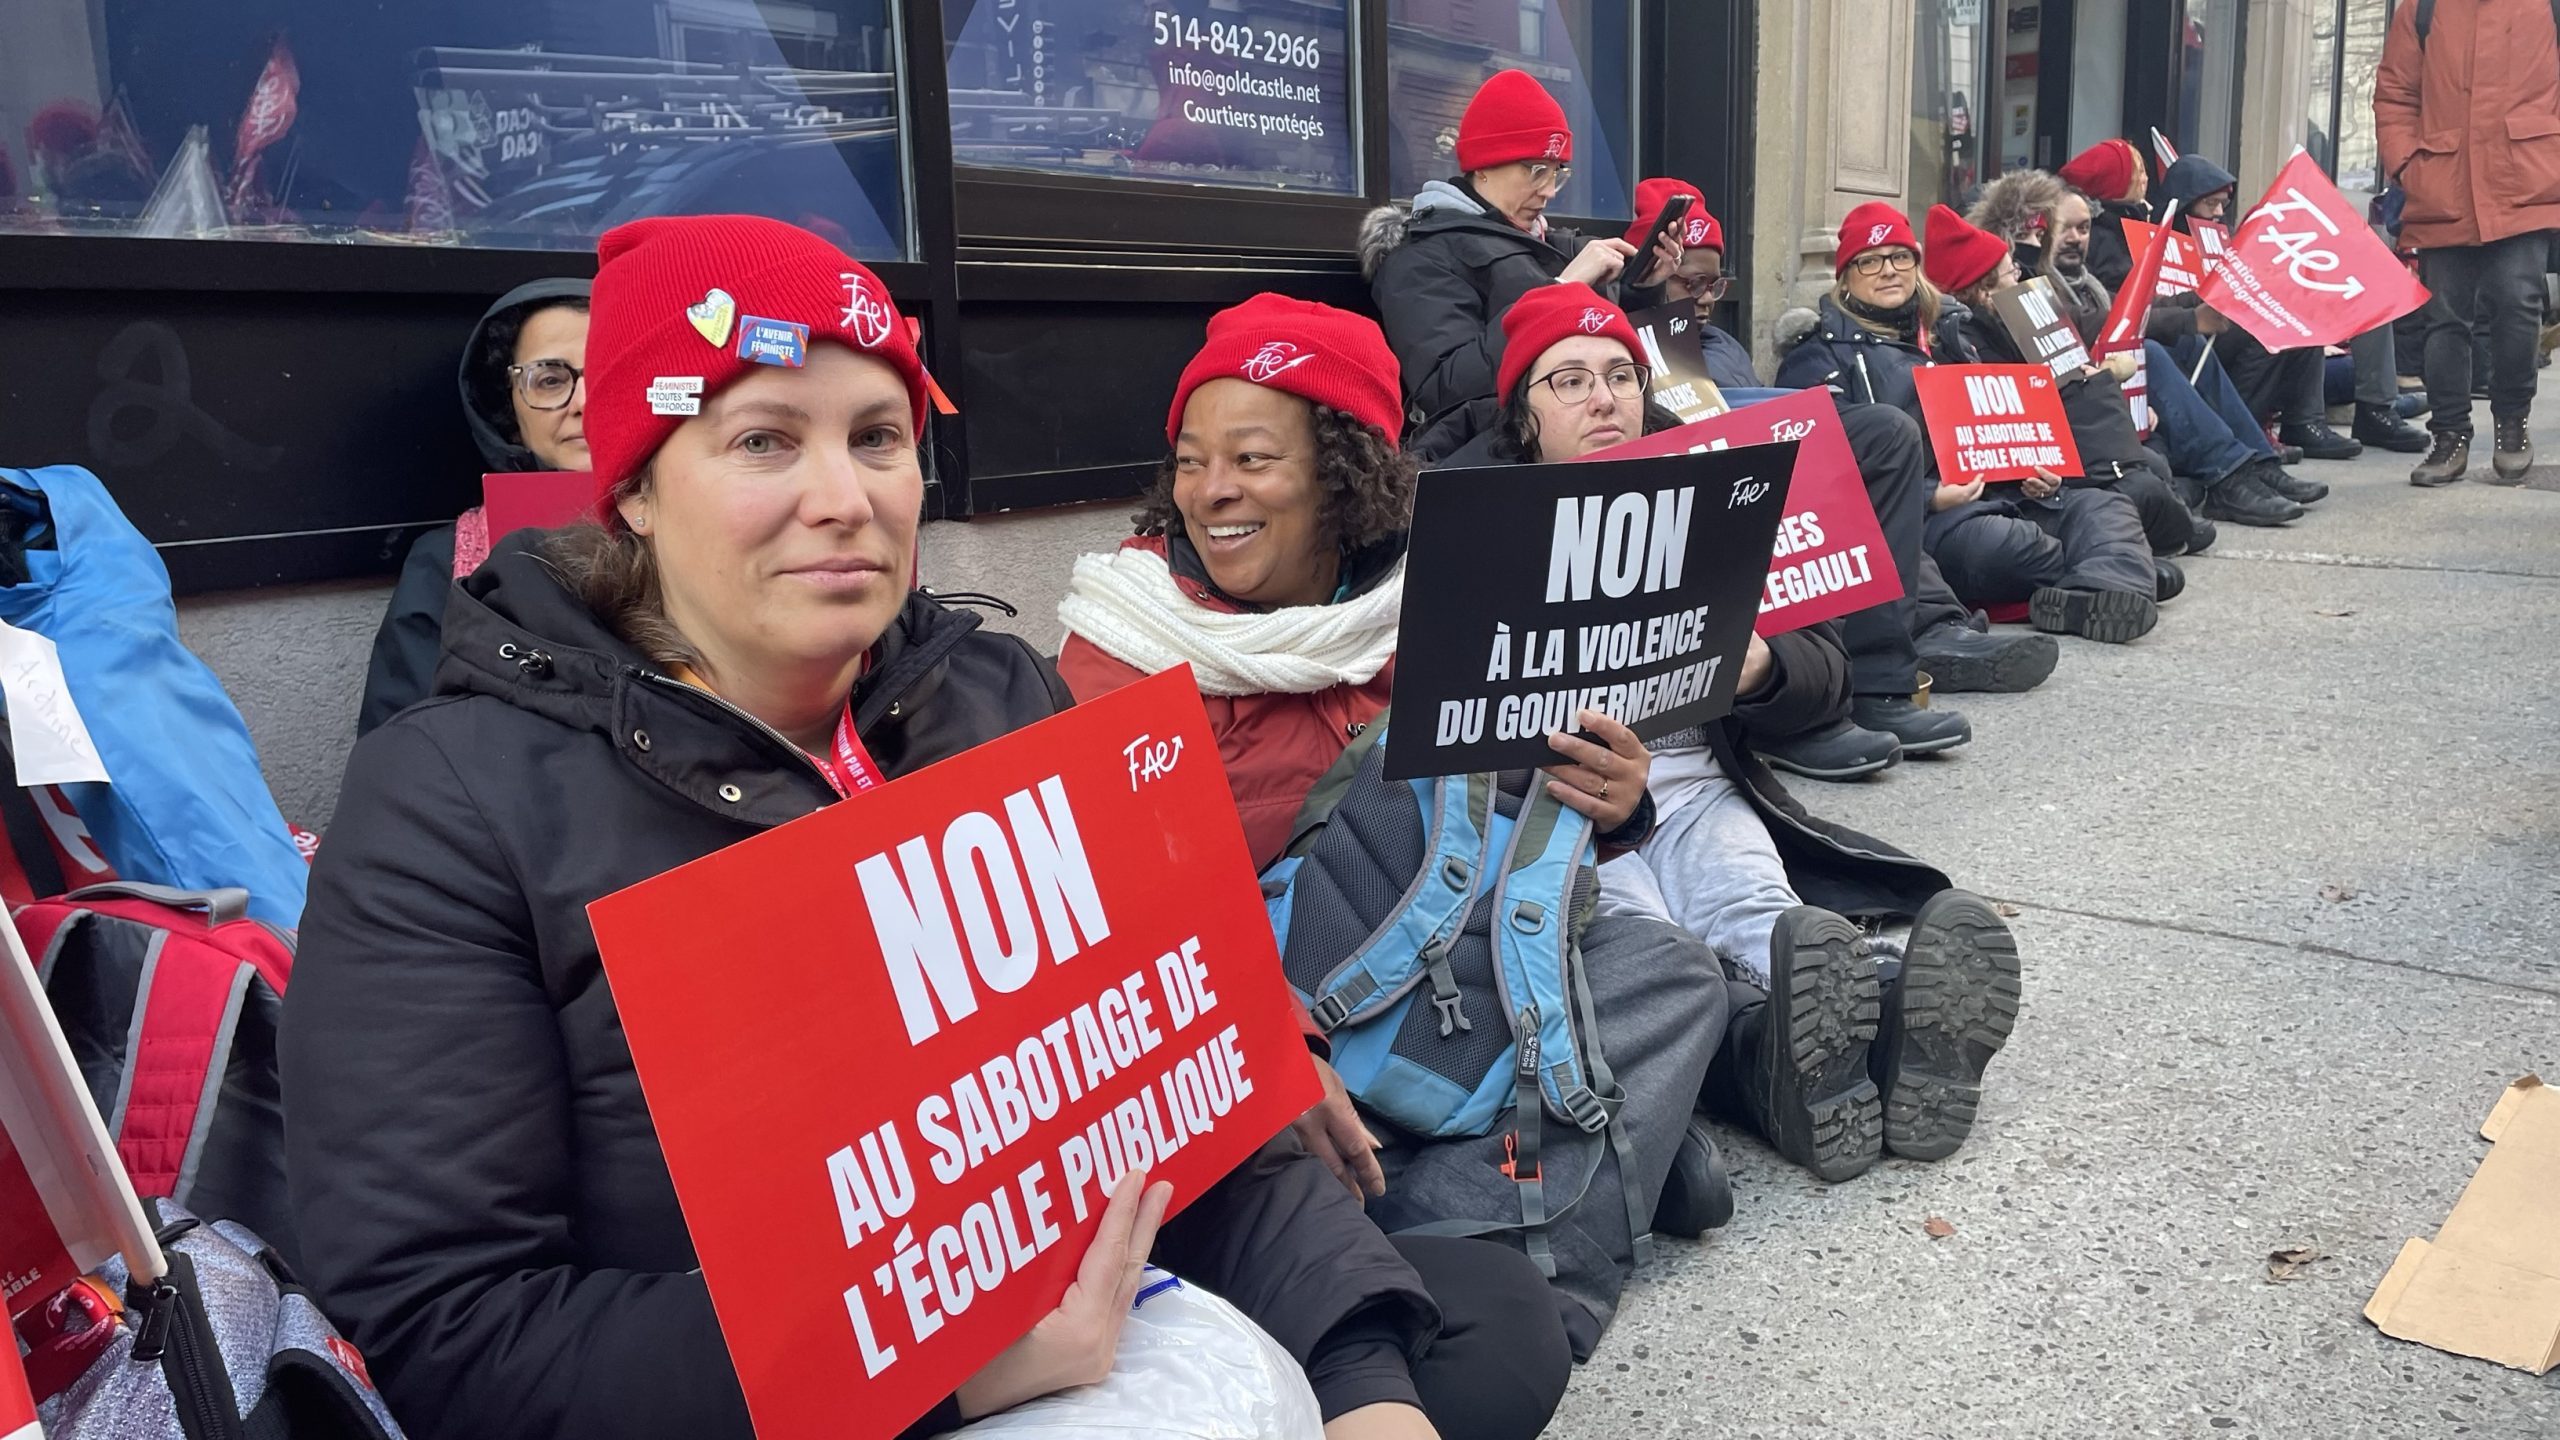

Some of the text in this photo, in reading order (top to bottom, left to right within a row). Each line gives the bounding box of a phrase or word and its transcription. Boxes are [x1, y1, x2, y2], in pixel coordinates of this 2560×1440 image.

[1154, 11, 1320, 69] 514-842-2966
[1169, 61, 1321, 104] info@goldcastle.net
[1183, 100, 1324, 140] Courtiers protégés
[756, 326, 793, 343] L'AVENIR
[2257, 290, 2313, 337] autonome
[751, 339, 795, 358] FÉMINISTE
[655, 380, 697, 391] FÉMINISTES
[655, 392, 682, 402] TOUTES
[1964, 375, 2025, 416] NON
[665, 402, 695, 412] FORCES
[1955, 422, 2055, 446] AU SABOTAGE DE
[1956, 446, 2066, 472] L'ÉCOLE PUBLIQUE
[1545, 486, 1695, 604] NON
[1758, 545, 1873, 614] LEGAULT
[1486, 605, 1710, 682] À LA VIOLENCE
[1435, 656, 1723, 747] DU GOUVERNEMENT
[843, 756, 865, 779] PAR
[856, 775, 873, 790] ET
[854, 774, 1111, 1047] NON
[826, 935, 1219, 1249] AU SABOTAGE DE
[843, 1025, 1255, 1380] L'ÉCOLE PUBLIQUE
